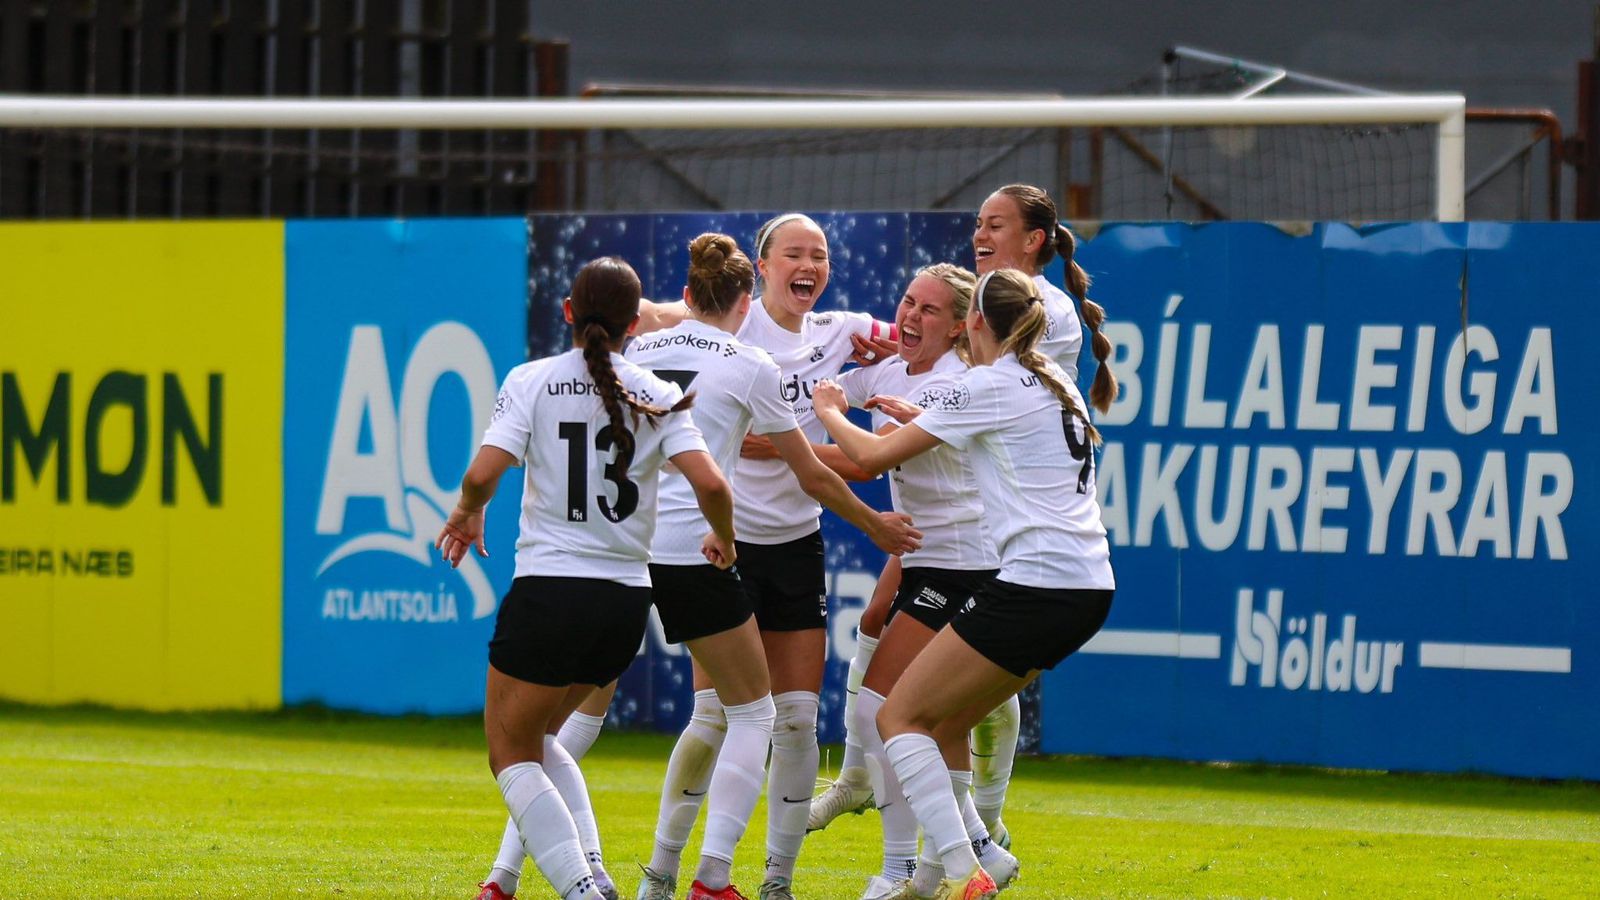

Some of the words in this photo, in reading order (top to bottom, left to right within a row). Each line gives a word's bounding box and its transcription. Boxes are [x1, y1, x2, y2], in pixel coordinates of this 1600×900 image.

[637, 334, 721, 352] unbroken
[1094, 295, 1558, 434] BÍLALEIGA
[558, 422, 639, 523] 13
[1061, 404, 1092, 495] 9
[1098, 442, 1574, 560] AKUREYRAR
[321, 582, 458, 622] ATLANTSOLÍA
[1230, 588, 1405, 693] Höldur
